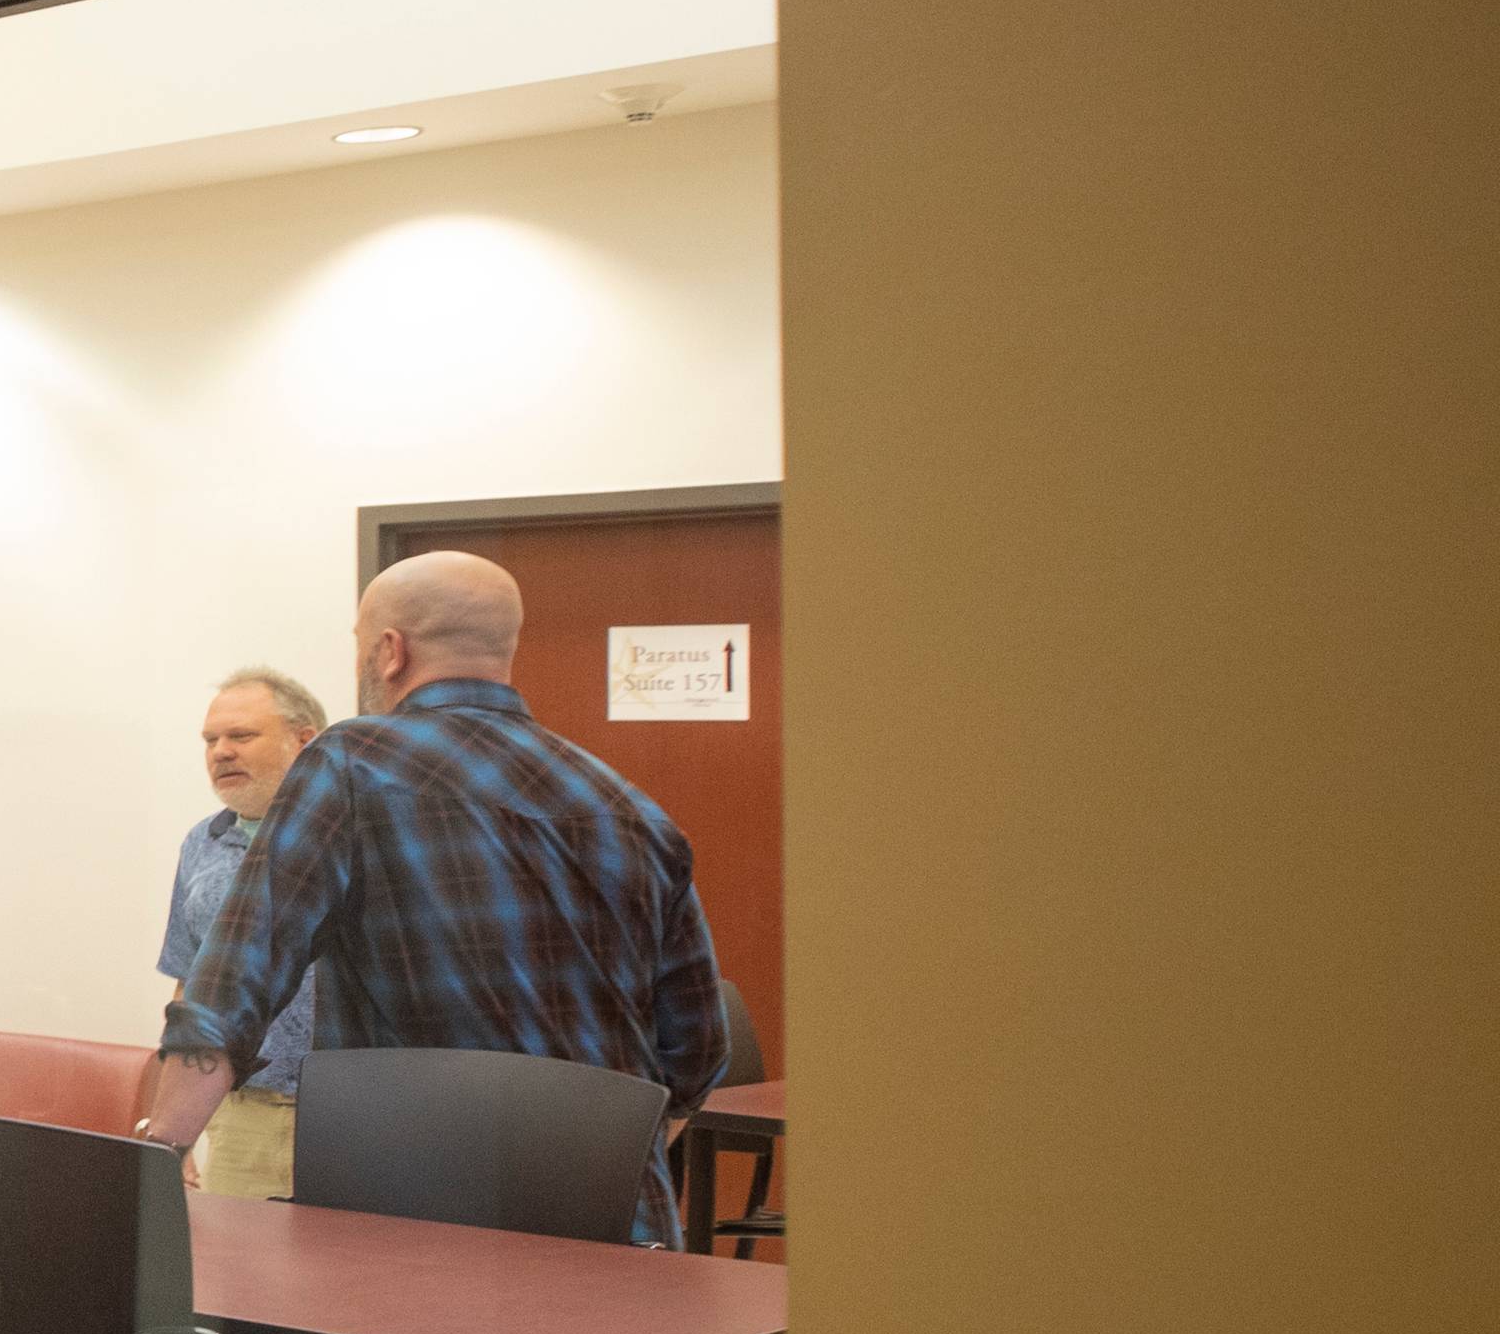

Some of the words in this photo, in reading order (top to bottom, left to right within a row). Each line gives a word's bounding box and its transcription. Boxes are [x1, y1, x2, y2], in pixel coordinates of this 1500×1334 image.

[632, 645, 710, 664] Paratus
[623, 673, 675, 692] Suite
[684, 673, 722, 692] 157
